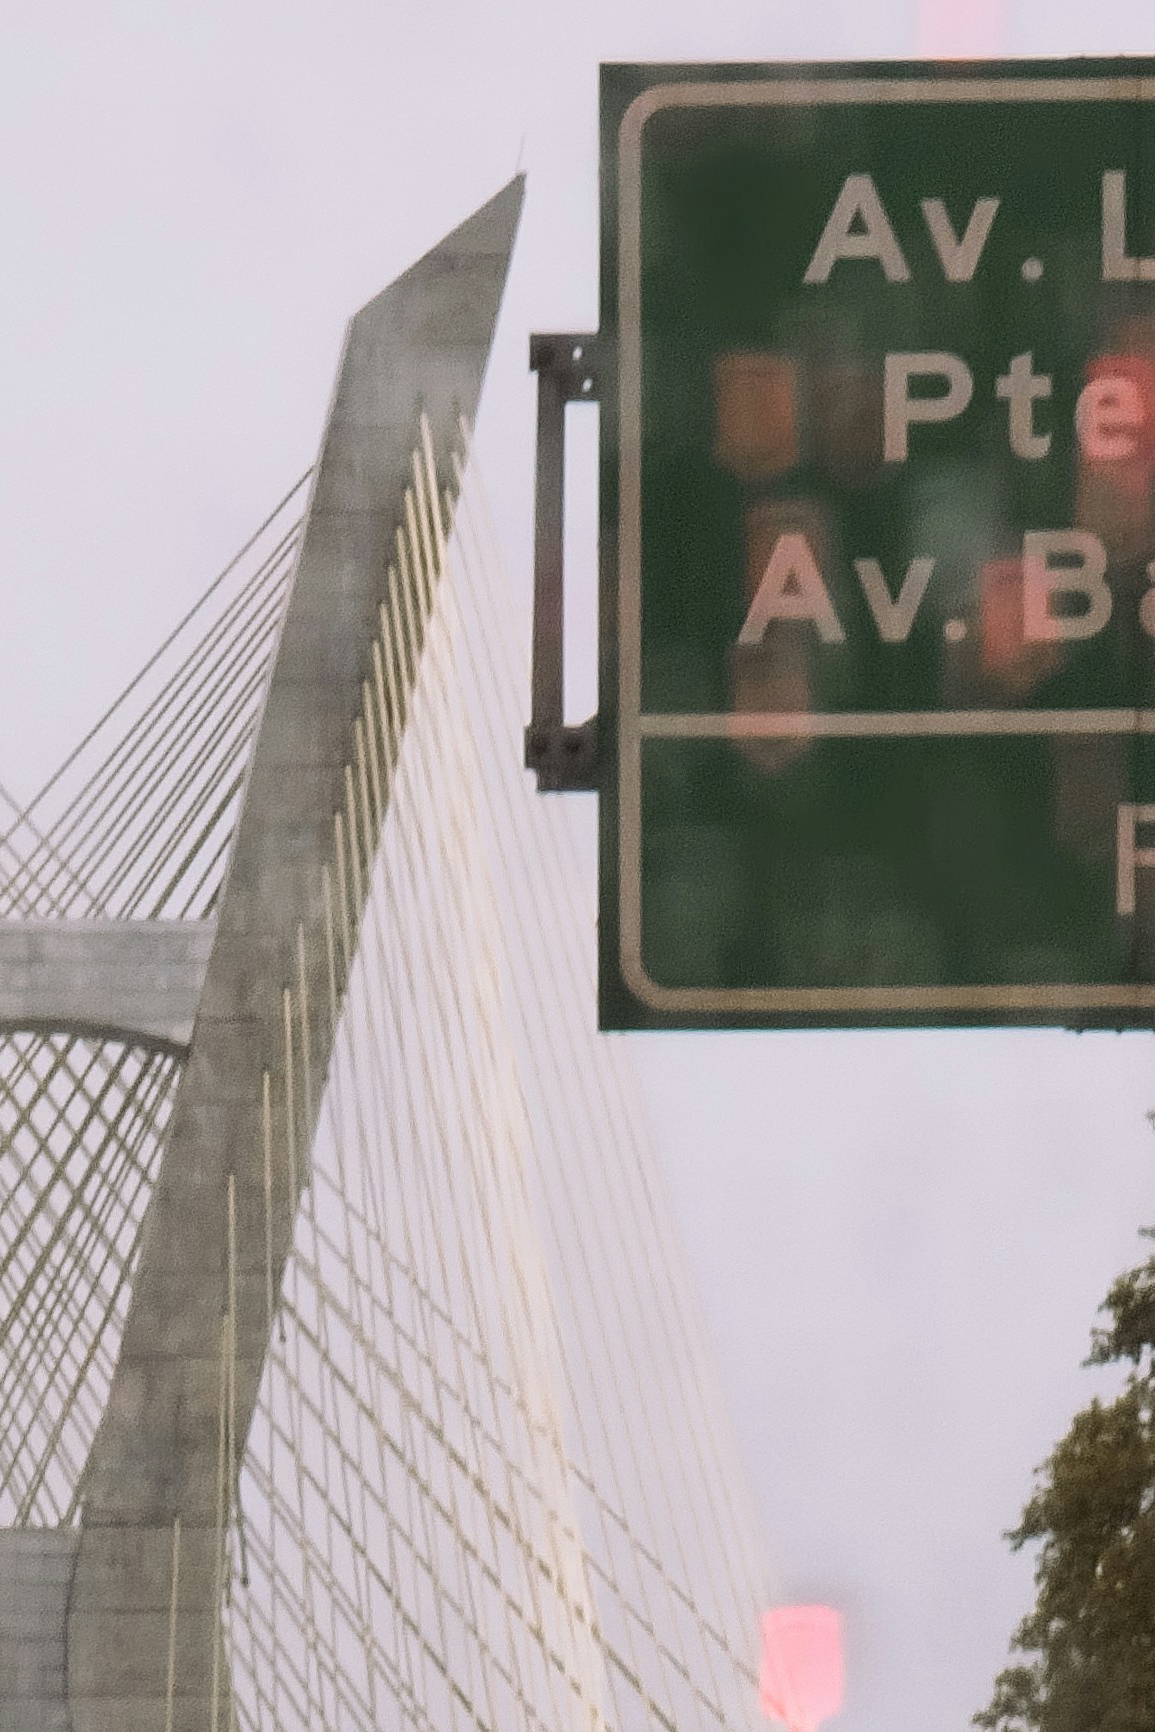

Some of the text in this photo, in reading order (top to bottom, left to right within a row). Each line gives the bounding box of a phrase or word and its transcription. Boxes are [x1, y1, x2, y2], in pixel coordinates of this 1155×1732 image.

[803, 173, 1044, 283] Av.
[883, 351, 1146, 461] Pte
[736, 530, 1155, 645] Av. B
